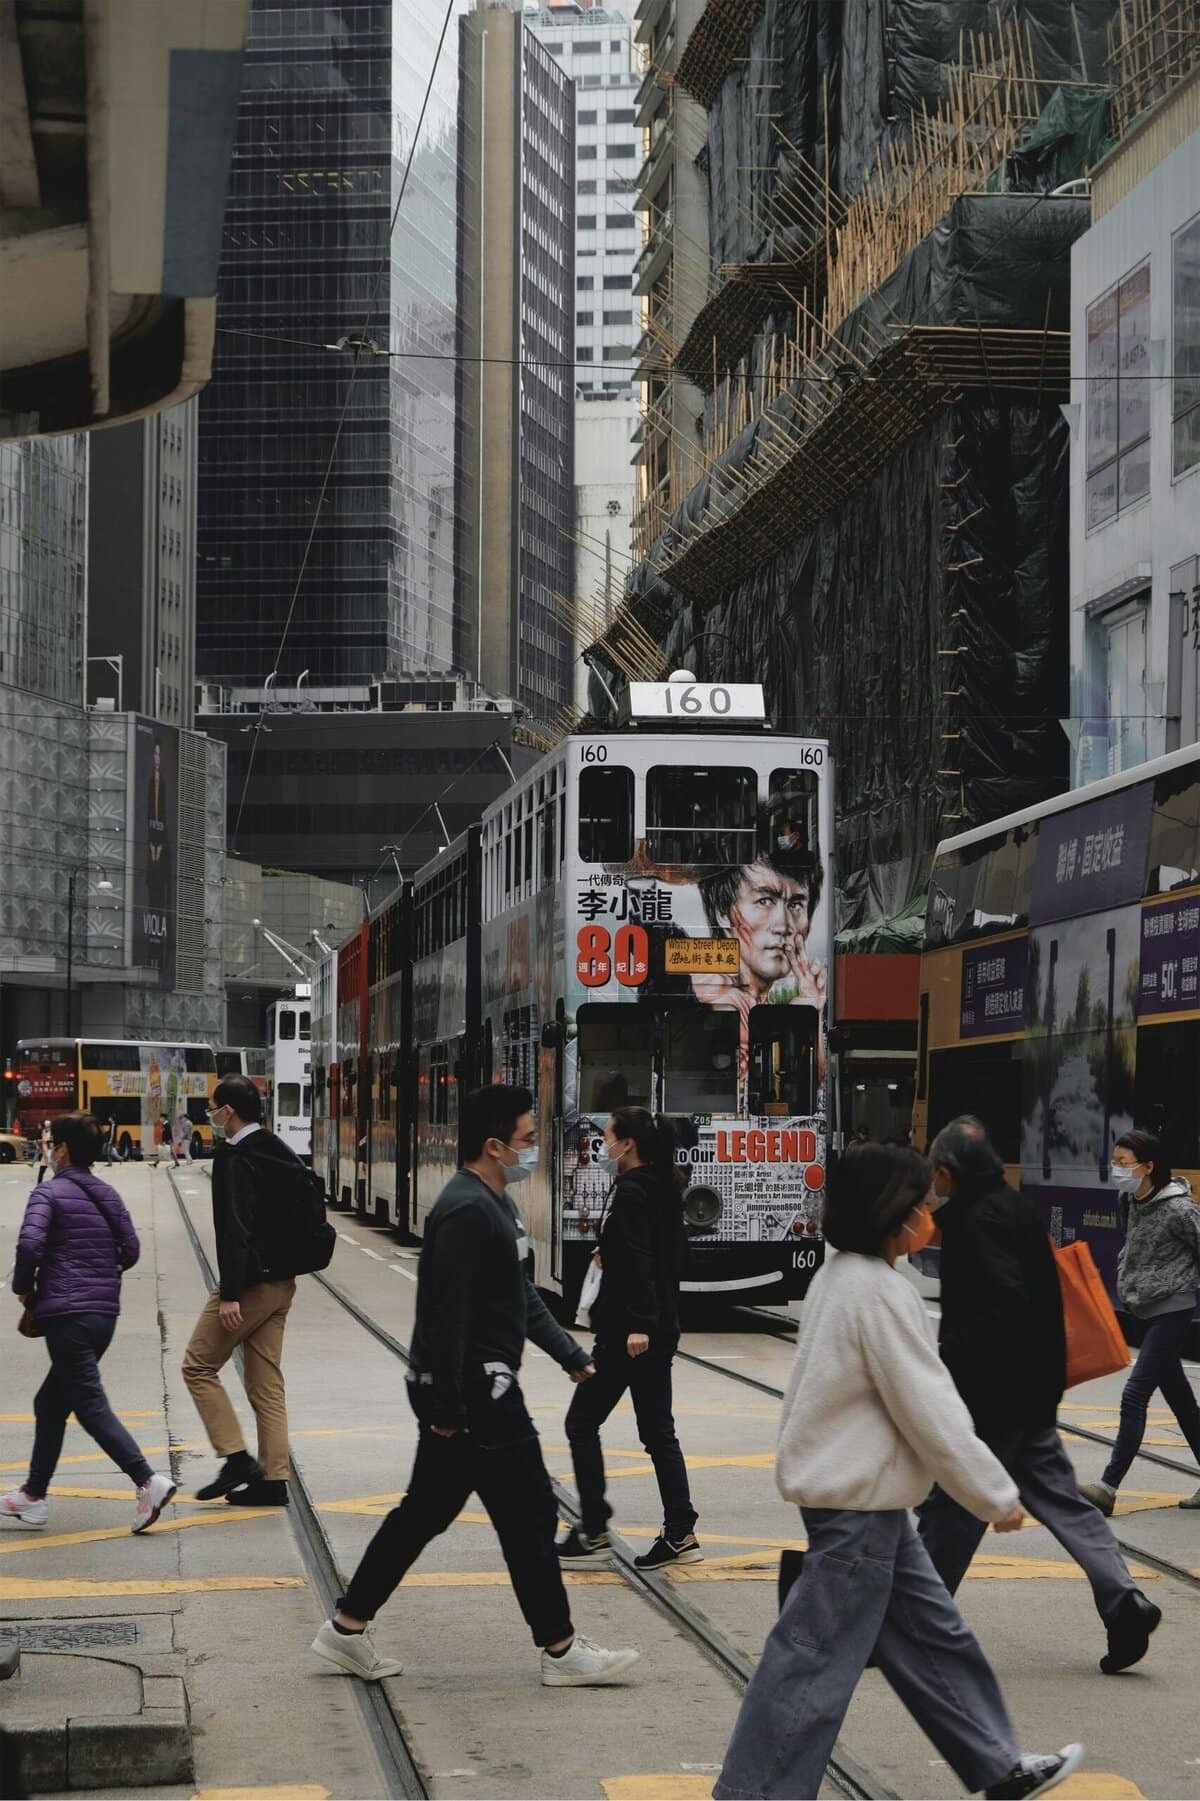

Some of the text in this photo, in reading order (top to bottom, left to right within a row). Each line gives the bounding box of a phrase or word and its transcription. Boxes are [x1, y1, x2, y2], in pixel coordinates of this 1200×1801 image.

[665, 687, 732, 714] 160
[580, 745, 607, 762] 160
[800, 748, 823, 766] 160
[576, 874, 625, 887] 一代傳奇
[577, 889, 673, 921] 李小龍
[143, 912, 167, 937] VIOLA
[668, 938, 737, 952] Whitty Street Depot
[576, 924, 649, 987] 80
[693, 1116, 711, 1125] 205
[690, 1149, 715, 1163] Our
[717, 1131, 816, 1163] LEGEND
[792, 1251, 816, 1269] 160
